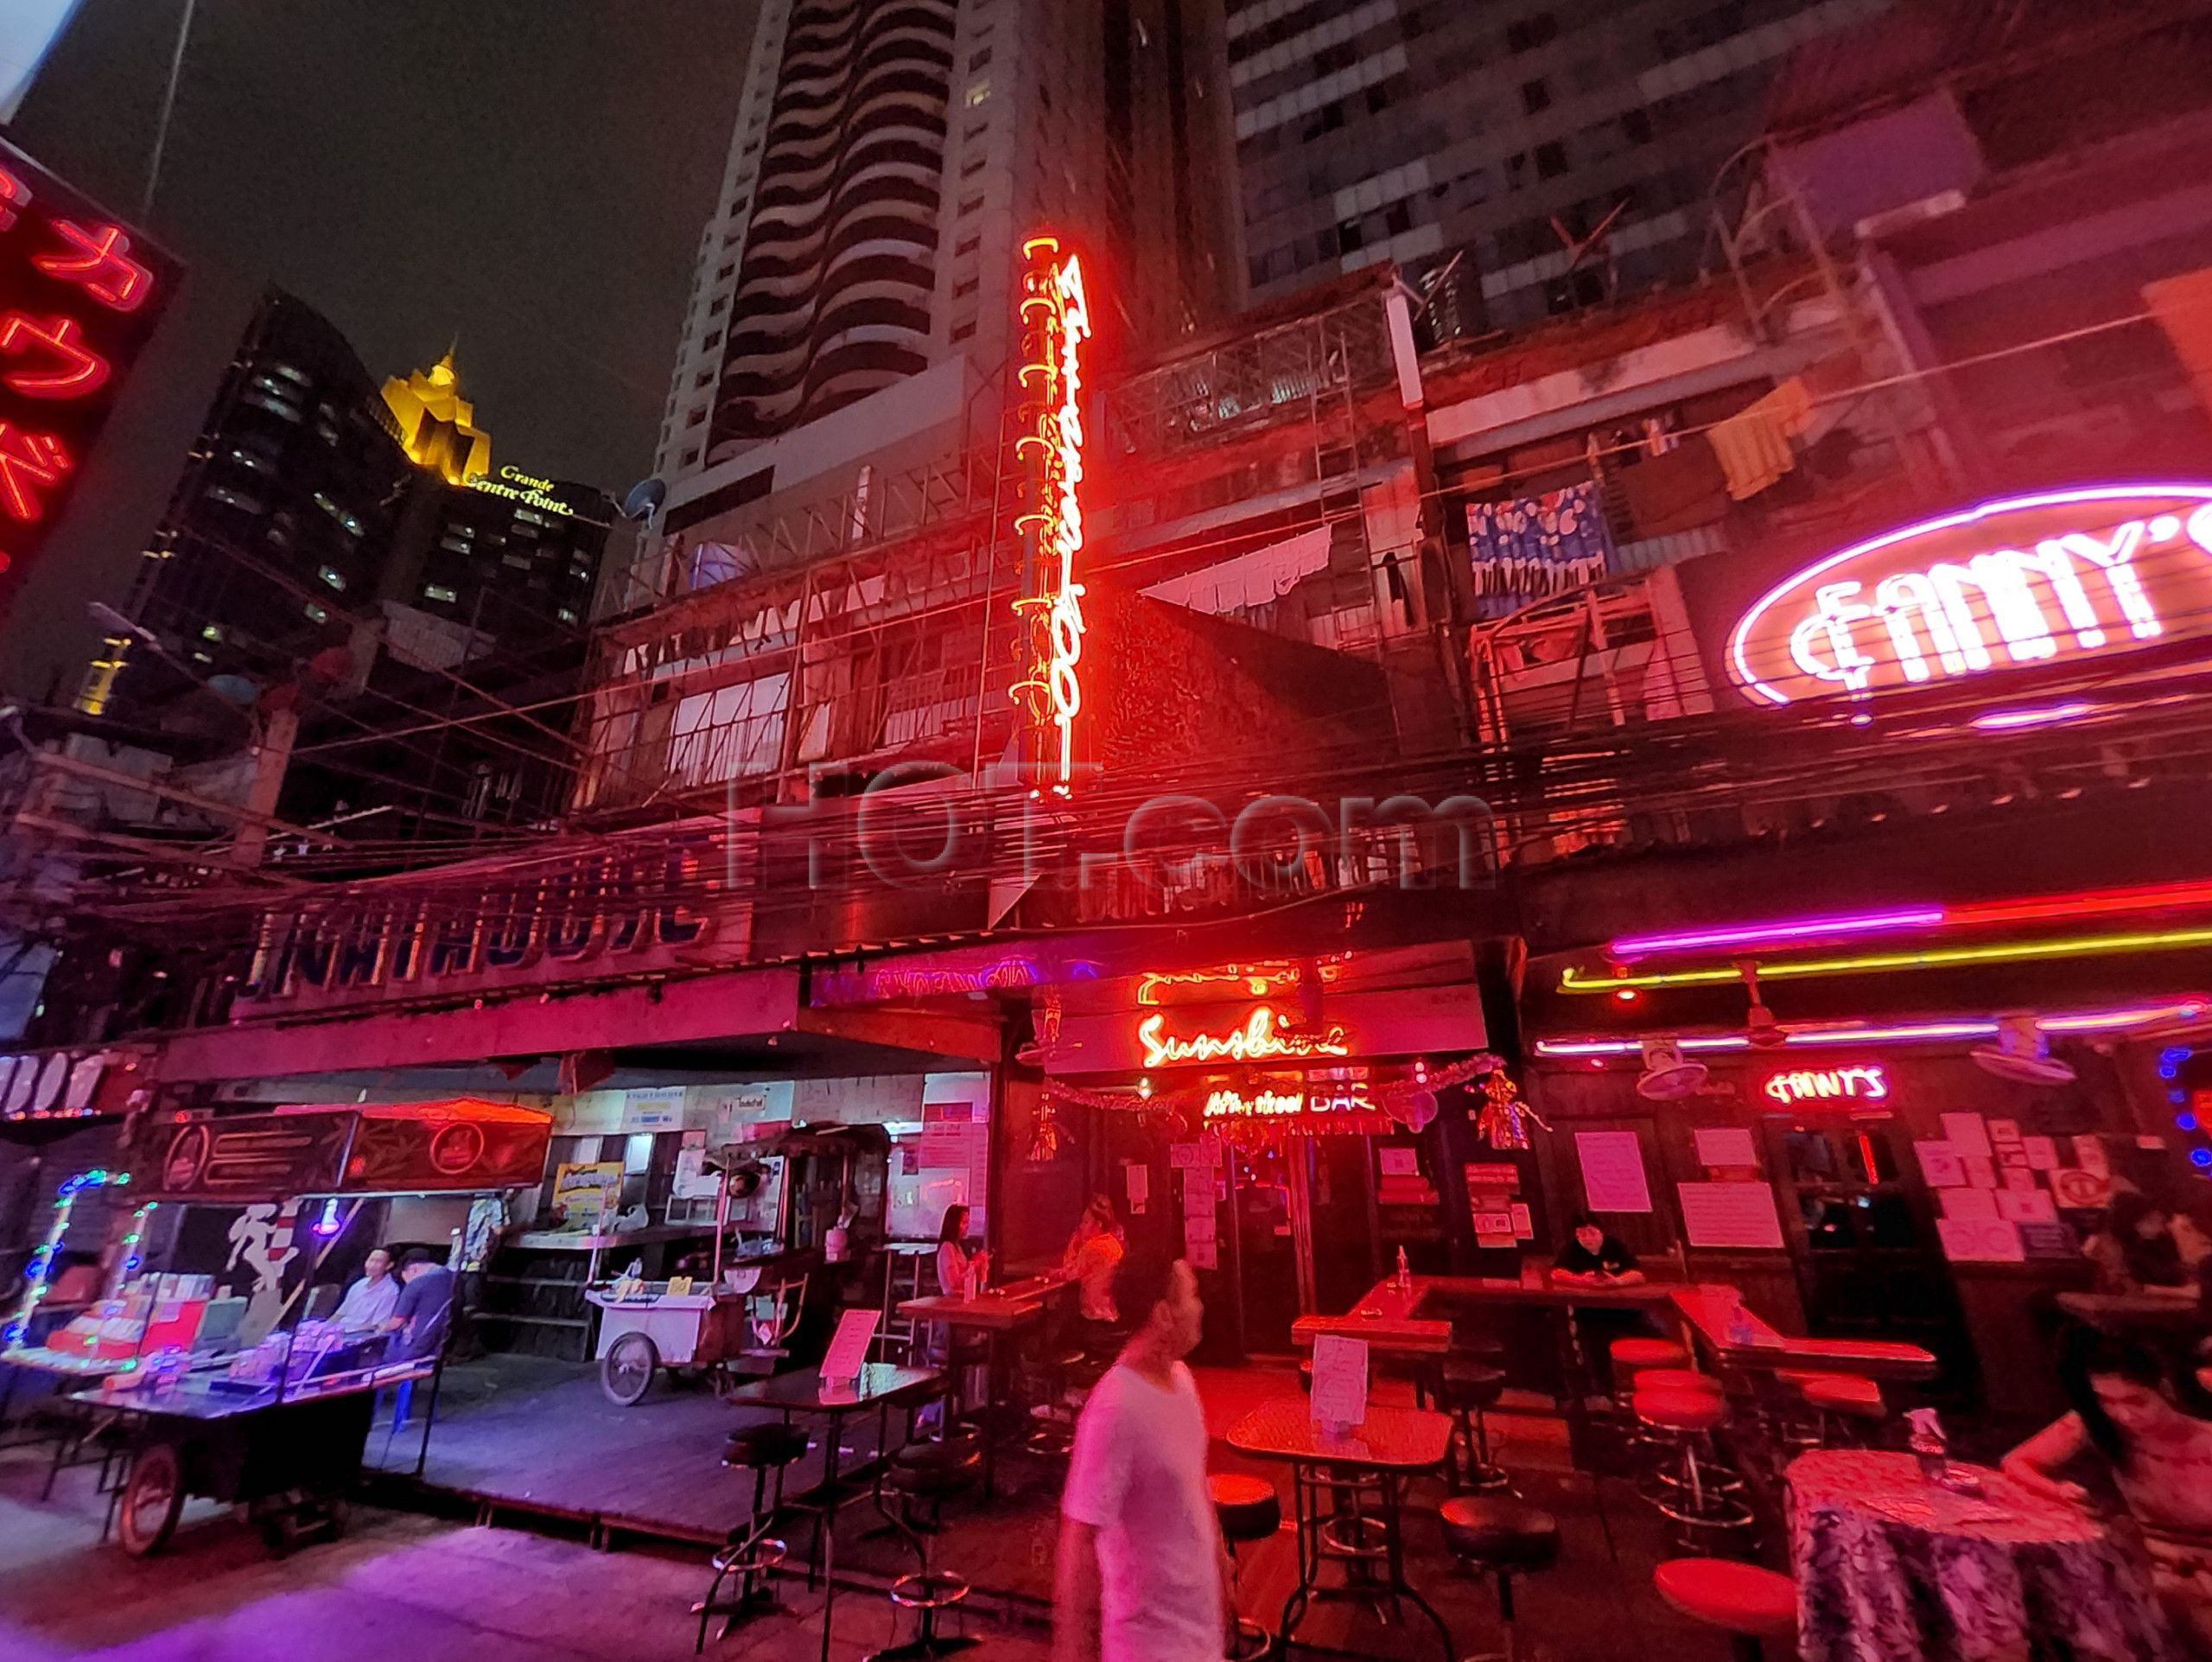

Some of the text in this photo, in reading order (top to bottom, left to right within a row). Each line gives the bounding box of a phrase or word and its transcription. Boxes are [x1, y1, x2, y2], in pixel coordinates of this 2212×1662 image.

[462, 471, 574, 515] Centre Point
[500, 465, 555, 492] Grande
[1310, 1082, 1376, 1112] BAR
